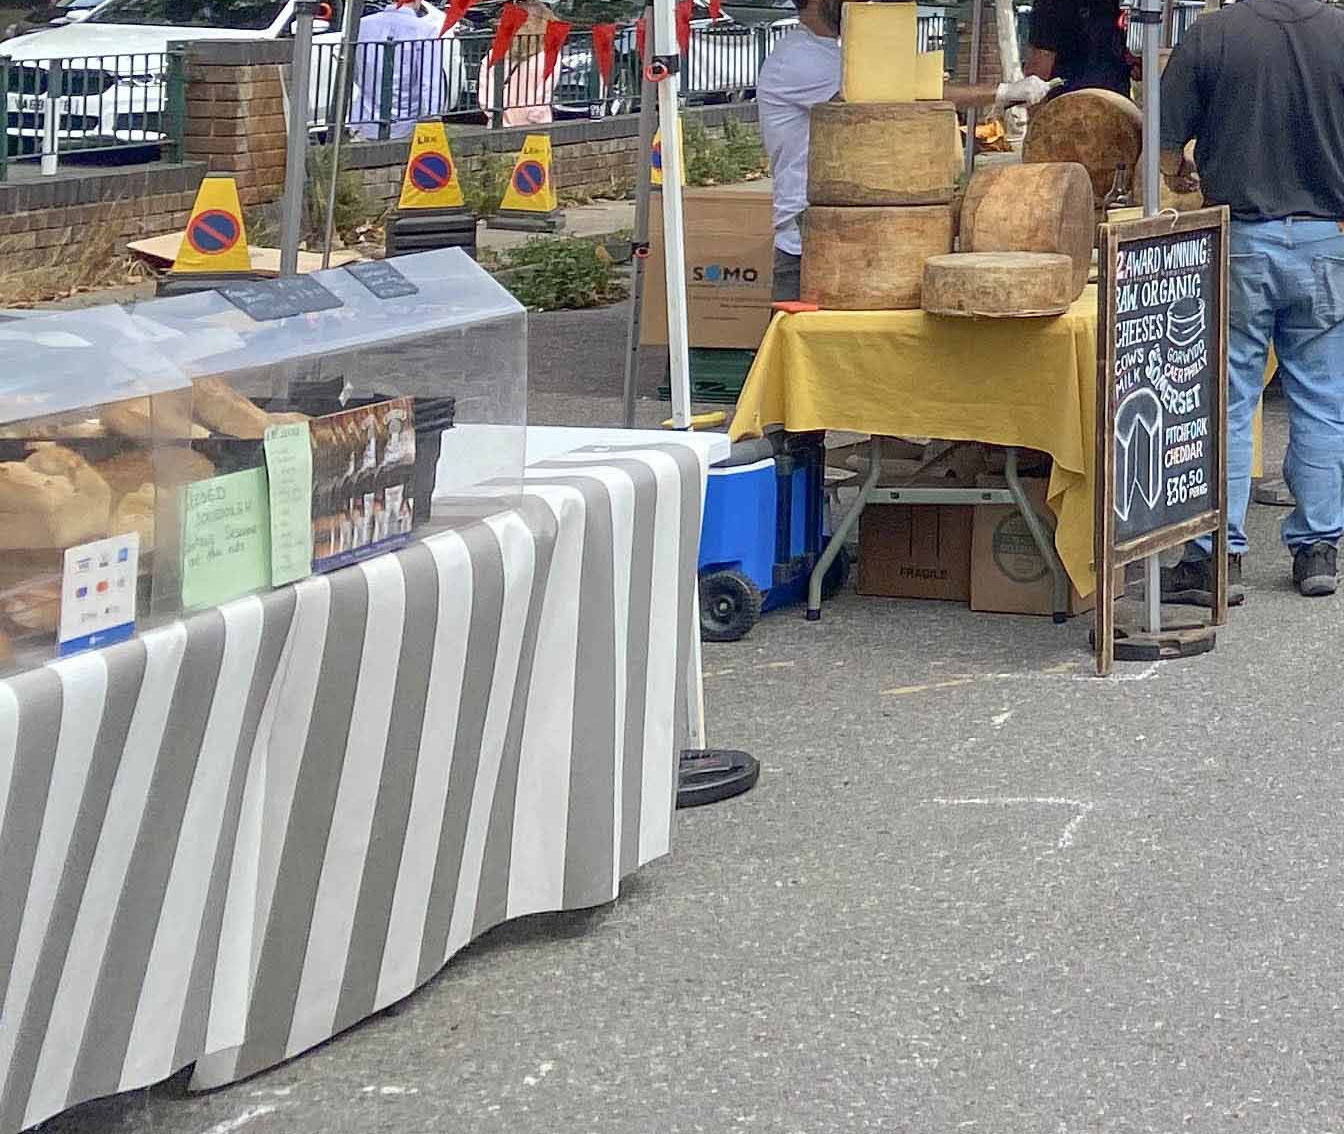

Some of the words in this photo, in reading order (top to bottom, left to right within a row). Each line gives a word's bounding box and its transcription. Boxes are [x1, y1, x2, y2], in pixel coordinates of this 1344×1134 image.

[1125, 247, 1161, 278] AWARD
[1163, 238, 1207, 270] WINNING
[1141, 273, 1201, 306] ORGANIC
[1116, 314, 1163, 348] CHEESES
[1115, 368, 1141, 400] MILK
[1166, 418, 1208, 446] PITCHFORK
[1164, 441, 1203, 467] CHEDDAR
[900, 568, 948, 579] FRAGILE
